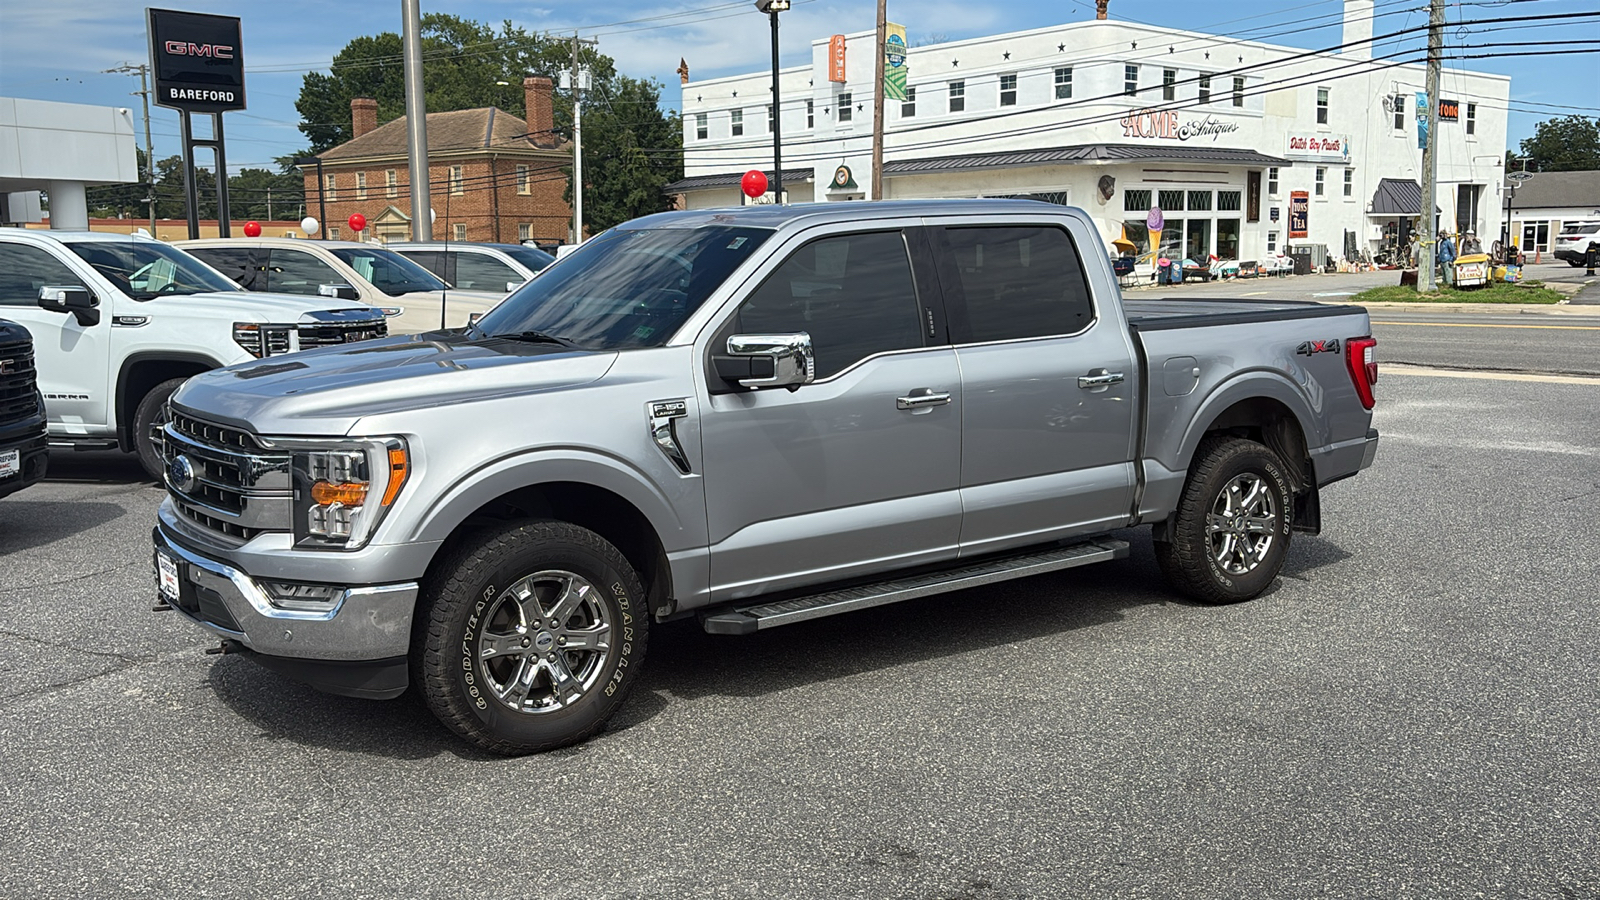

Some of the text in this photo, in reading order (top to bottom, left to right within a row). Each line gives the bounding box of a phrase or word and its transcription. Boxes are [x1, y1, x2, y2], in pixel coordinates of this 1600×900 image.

[165, 41, 233, 59] GMC
[836, 38, 844, 79] ACME
[170, 88, 234, 102] BAREFORD
[1120, 107, 1178, 139] ACME
[1190, 113, 1239, 141] Antiques
[1290, 136, 1340, 153] Dutch Boy Paints
[1293, 217, 1306, 229] TEA
[654, 402, 685, 411] F-150
[1265, 463, 1290, 536] WRANGLER
[1204, 512, 1232, 587] GOODYEAR
[462, 584, 495, 710] GOODYEAR
[604, 581, 634, 698] WRANGLER
